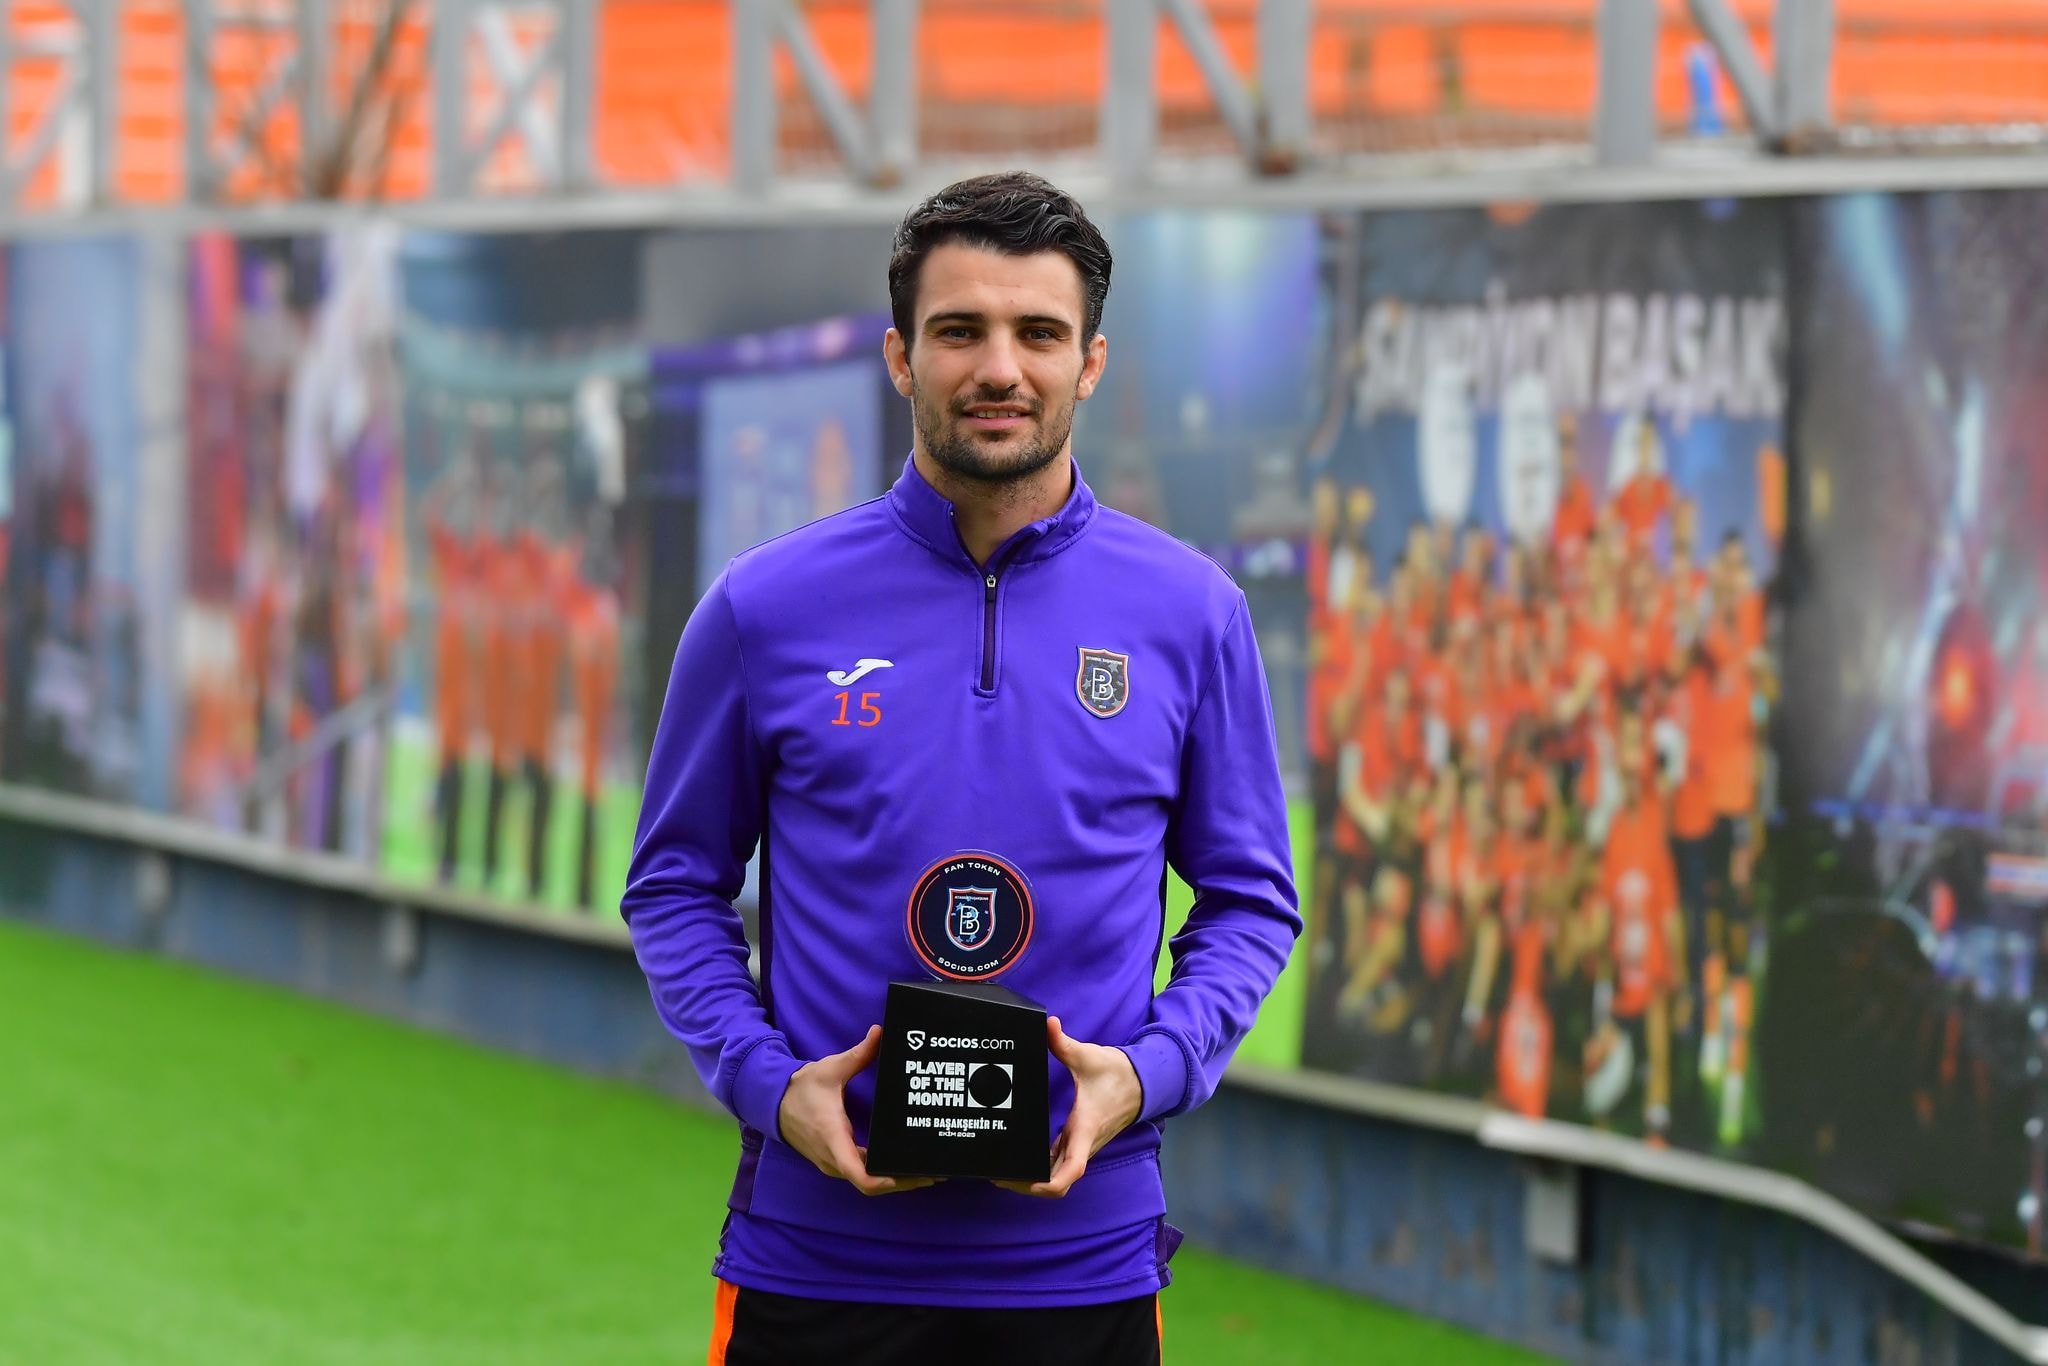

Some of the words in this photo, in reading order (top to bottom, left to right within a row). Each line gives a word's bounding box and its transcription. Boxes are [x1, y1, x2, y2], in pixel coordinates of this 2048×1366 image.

[831, 691, 882, 727] 15
[944, 862, 964, 874] FAN
[968, 862, 1001, 876] TOKEN
[938, 957, 999, 972] SOCIOS.COM
[930, 1037, 1014, 1050] SOCIOS.com
[905, 1060, 966, 1076] PLAYER
[909, 1076, 931, 1090] OF
[934, 1077, 965, 1091] THE
[907, 1092, 964, 1107] MONTH
[906, 1117, 931, 1127] RAMS
[933, 1117, 990, 1131] BAŞAKŞEHİR
[992, 1120, 1007, 1130] FK.
